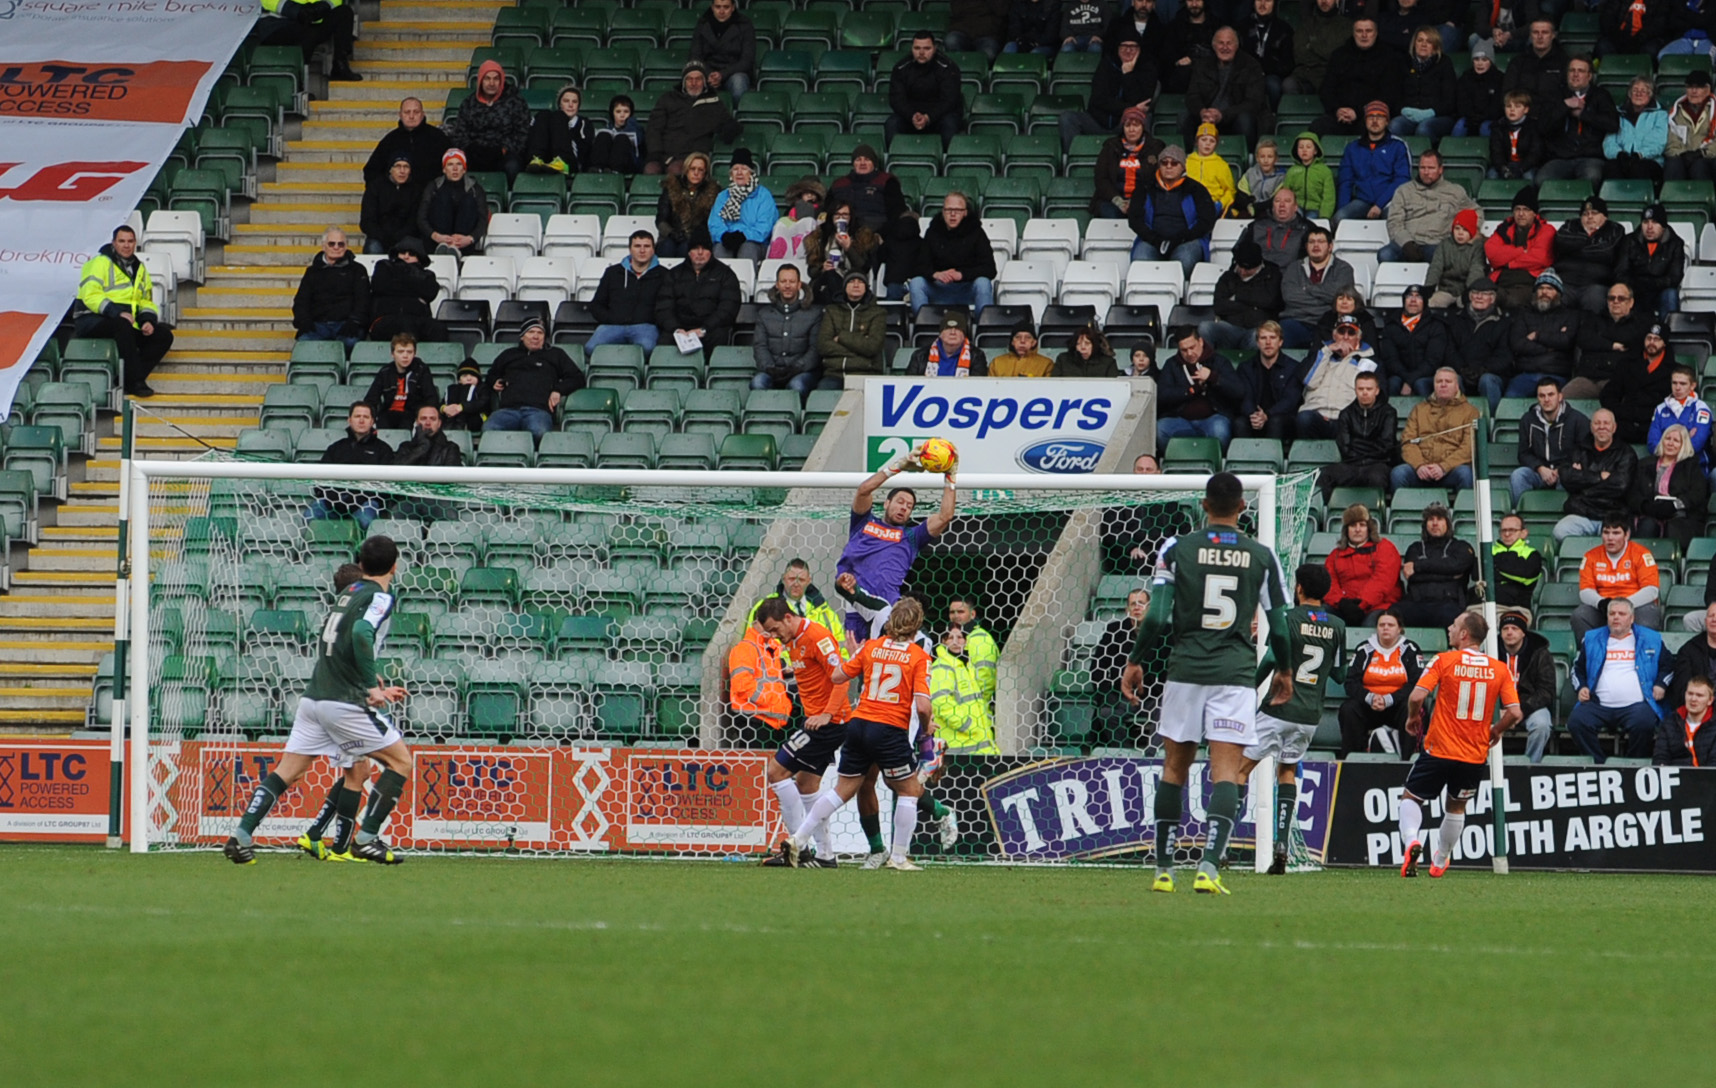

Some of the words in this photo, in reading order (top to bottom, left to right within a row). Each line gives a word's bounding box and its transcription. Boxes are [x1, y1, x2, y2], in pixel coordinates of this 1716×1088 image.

[23, 0, 100, 13] square
[1, 65, 136, 84] LTC
[0, 249, 92, 269] broking
[882, 384, 1112, 439] Vospers
[1040, 443, 1100, 471] Ford
[863, 523, 902, 540] easyJet
[1198, 547, 1251, 569] NELSON
[1596, 572, 1631, 584] easyJet
[1201, 574, 1239, 630] 5
[322, 612, 344, 657] 4
[1301, 623, 1334, 640] MELLOR
[871, 647, 912, 664] GRIFFITHS
[1295, 643, 1325, 685] 2
[1367, 665, 1405, 677] easyJet
[1454, 664, 1496, 680] HOWELLS
[867, 662, 903, 704] 12
[1455, 680, 1488, 721] 11
[21, 752, 87, 781] LTC
[234, 755, 281, 783] LT
[448, 759, 514, 788] LTC
[663, 763, 730, 792] LTC
[20, 782, 90, 795] POWERED
[1530, 769, 1624, 810] BEER
[1635, 766, 1681, 802] OF
[20, 796, 75, 808] ACCESS
[663, 793, 733, 806] POWERED
[662, 806, 718, 820] ACCESS
[1564, 807, 1704, 852] ARGYLE
